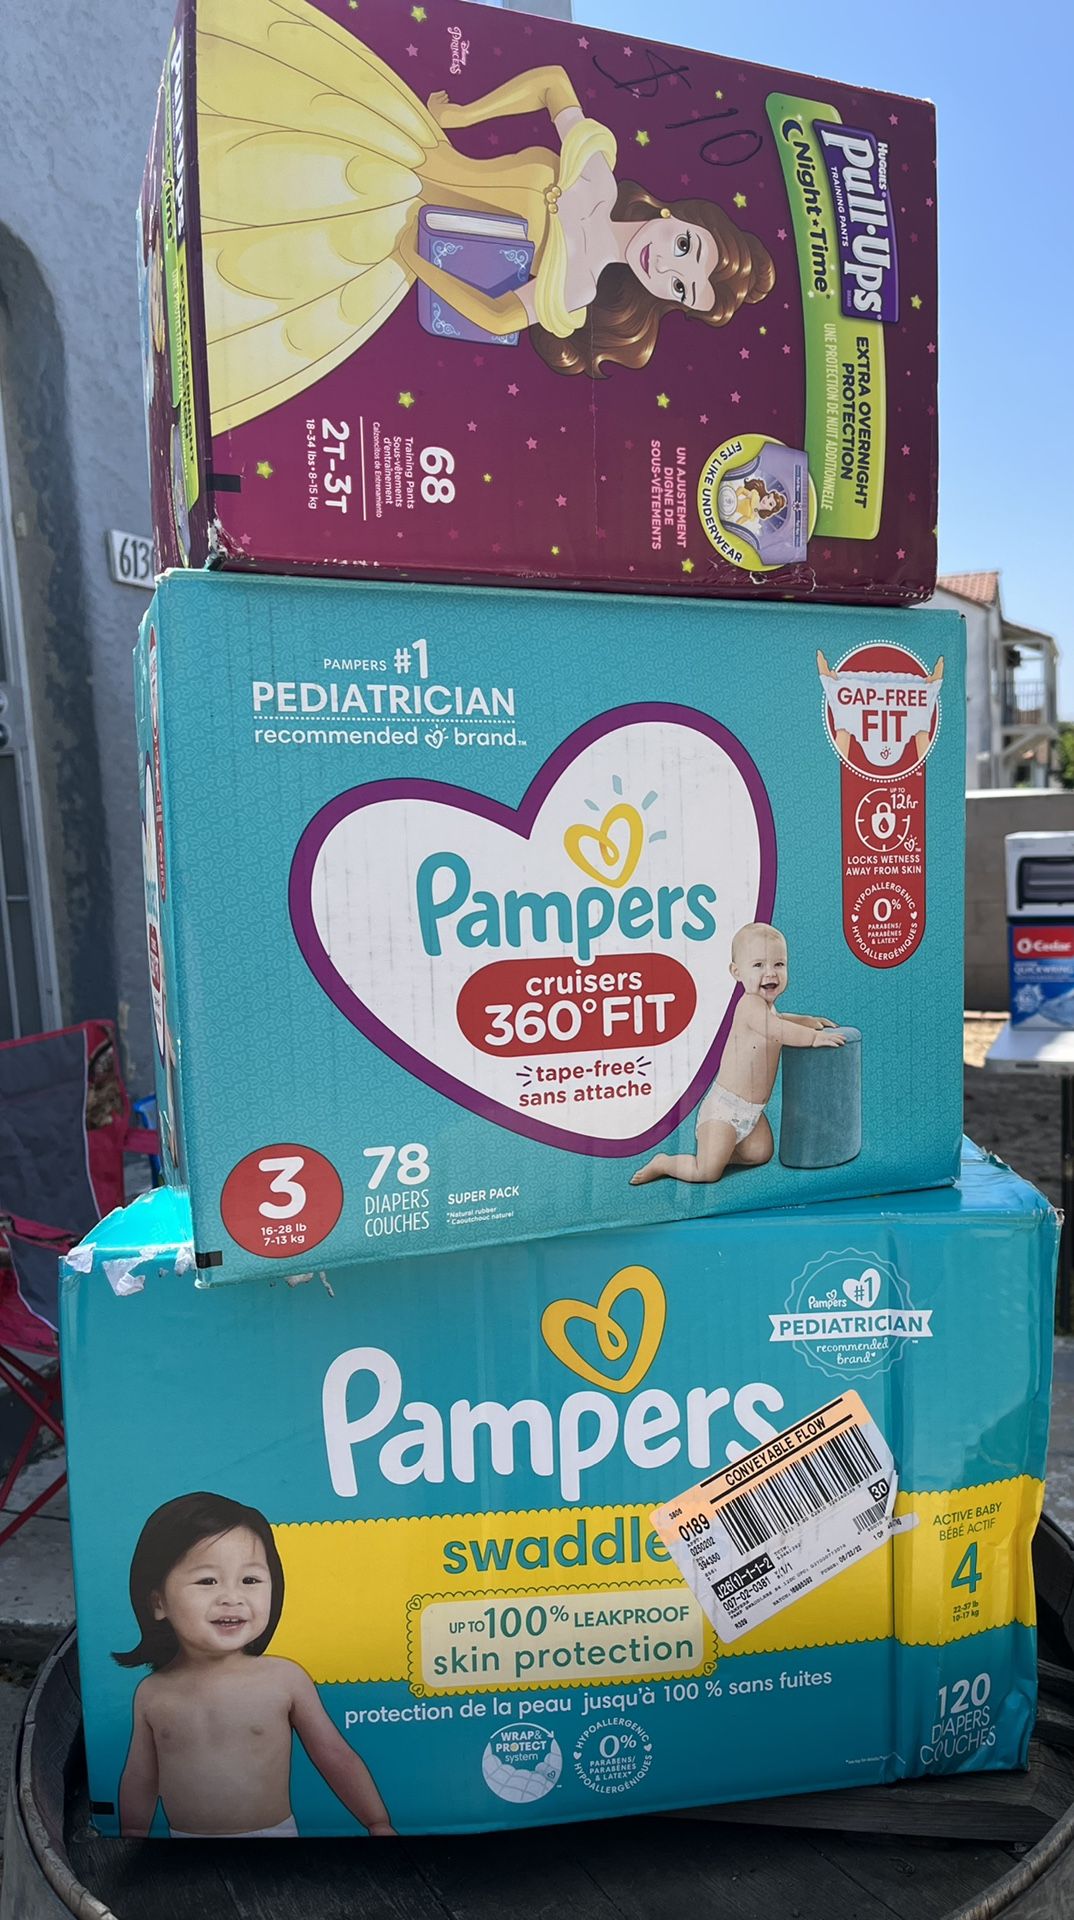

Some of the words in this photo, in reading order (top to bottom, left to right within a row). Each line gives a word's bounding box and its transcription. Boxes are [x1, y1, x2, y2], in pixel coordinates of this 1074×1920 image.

[877, 142, 889, 190] HUGGIES
[793, 141, 822, 216] Night
[809, 228, 829, 293] Time
[830, 166, 846, 213] TRAINING
[840, 214, 849, 247] PANTS
[824, 323, 836, 343] UNE
[825, 345, 838, 400] PROTECTION
[856, 336, 871, 396] EXTRA
[826, 402, 839, 415] DE
[840, 363, 855, 480] PROTECTION
[306, 419, 316, 448] 18-34
[372, 422, 381, 461] Calzoncitos
[825, 417, 839, 439] NUIT
[322, 418, 352, 514] 2T-3T
[405, 437, 415, 479] Training
[676, 447, 686, 465] UN
[720, 441, 743, 461] FITS
[854, 402, 871, 508] OVERNIGHT
[383, 437, 394, 504] d'entraînement
[393, 436, 403, 507] Sous-vêtements
[420, 446, 455, 503] 68
[664, 467, 674, 505] DIGNE
[704, 459, 722, 486] LIKE
[820, 440, 838, 511] ADDITIONNELLE
[308, 497, 318, 510] kg
[406, 481, 415, 509] Pants
[651, 440, 662, 550] SOUS-VÊTEMENTS
[676, 467, 687, 548] AJUSTEMENT
[664, 510, 674, 526] DE
[701, 490, 743, 563] UNDERWEAR
[120, 538, 155, 580] 613
[323, 658, 387, 671] PAMPERS
[394, 638, 429, 679] #1
[252, 681, 515, 716] PEDIATRICIAN
[837, 687, 928, 707] GAP-FREE
[254, 726, 418, 745] recommended
[862, 710, 908, 742] FIT
[890, 793, 919, 810] 12hr
[846, 867, 871, 876] AWAY
[874, 866, 899, 875] FROM
[902, 865, 921, 874] SKIN
[847, 855, 878, 864] LOCKS
[880, 854, 920, 864] WETNESS
[416, 852, 717, 961] Pampers
[853, 882, 916, 912] HYPOALLERGENIC
[873, 898, 901, 922] 0%
[851, 922, 918, 961] HYPOALLERGÉNIQUES
[526, 970, 642, 996] cruisers
[536, 1060, 636, 1083] tape-free
[519, 1091, 566, 1107] sans
[574, 1080, 652, 1103] attache
[363, 1142, 431, 1190] 78
[258, 1156, 307, 1220] 3
[365, 1189, 430, 1216] DIAPERS
[448, 1190, 486, 1205] SUPER
[489, 1185, 520, 1199] PACK
[365, 1210, 430, 1238] COUCHES
[475, 1207, 497, 1215] rubber
[491, 1211, 514, 1219] naturel
[261, 1224, 293, 1237] 16-28
[295, 1223, 307, 1234] lb
[264, 1236, 288, 1247] 7-13
[291, 1233, 305, 1245] kg
[808, 1295, 847, 1310] Pampers
[854, 1277, 873, 1303] #1
[779, 1315, 923, 1336] PEDIATRICIAN
[816, 1337, 889, 1353] recommended
[837, 1351, 872, 1364] brand
[322, 1346, 784, 1502] Pampers
[725, 1436, 795, 1486] CONVEYABLE
[794, 1417, 826, 1444] FLOW
[871, 1481, 889, 1500] 30
[678, 1513, 710, 1542] 0189
[932, 1507, 973, 1525] ACTIVE
[976, 1502, 1002, 1517] BABY
[939, 1523, 964, 1541] BÉBÉ
[967, 1518, 996, 1533] ACTIF
[443, 1516, 674, 1575] swaddle
[689, 1536, 716, 1557] 0250202
[716, 1556, 774, 1600] J26(1)-1-1-2
[951, 1541, 983, 1594] 4
[722, 1576, 771, 1611] 007-02-0381
[953, 1602, 972, 1613] 22-37
[972, 1600, 979, 1608] lb
[449, 1622, 466, 1634] UP
[468, 1620, 485, 1633] TO
[484, 1605, 569, 1639] 100%
[574, 1606, 690, 1628] LEAKPROOF
[952, 1612, 970, 1622] 10-17
[971, 1609, 979, 1618] kg
[434, 1647, 500, 1676] skin
[515, 1635, 694, 1678] protection
[345, 1704, 453, 1728] protection
[459, 1700, 487, 1717] de
[493, 1697, 512, 1716] la
[518, 1698, 572, 1724] peau
[580, 1688, 656, 1716] jusqu'à
[664, 1684, 699, 1702] 100
[704, 1681, 723, 1698] %
[728, 1676, 773, 1695] sans
[779, 1669, 833, 1689] fuites
[938, 1673, 991, 1719] 120
[501, 1730, 542, 1741] WRAP&
[575, 1717, 650, 1749] HYPOALLERGENIC
[931, 1705, 990, 1744] DIAPERS
[496, 1741, 547, 1753] PROTECT
[505, 1752, 539, 1763] system
[600, 1734, 637, 1758] 0%
[919, 1725, 996, 1765] COUCHES
[574, 1754, 653, 1794] HYPOALLERGÉNIQUES
